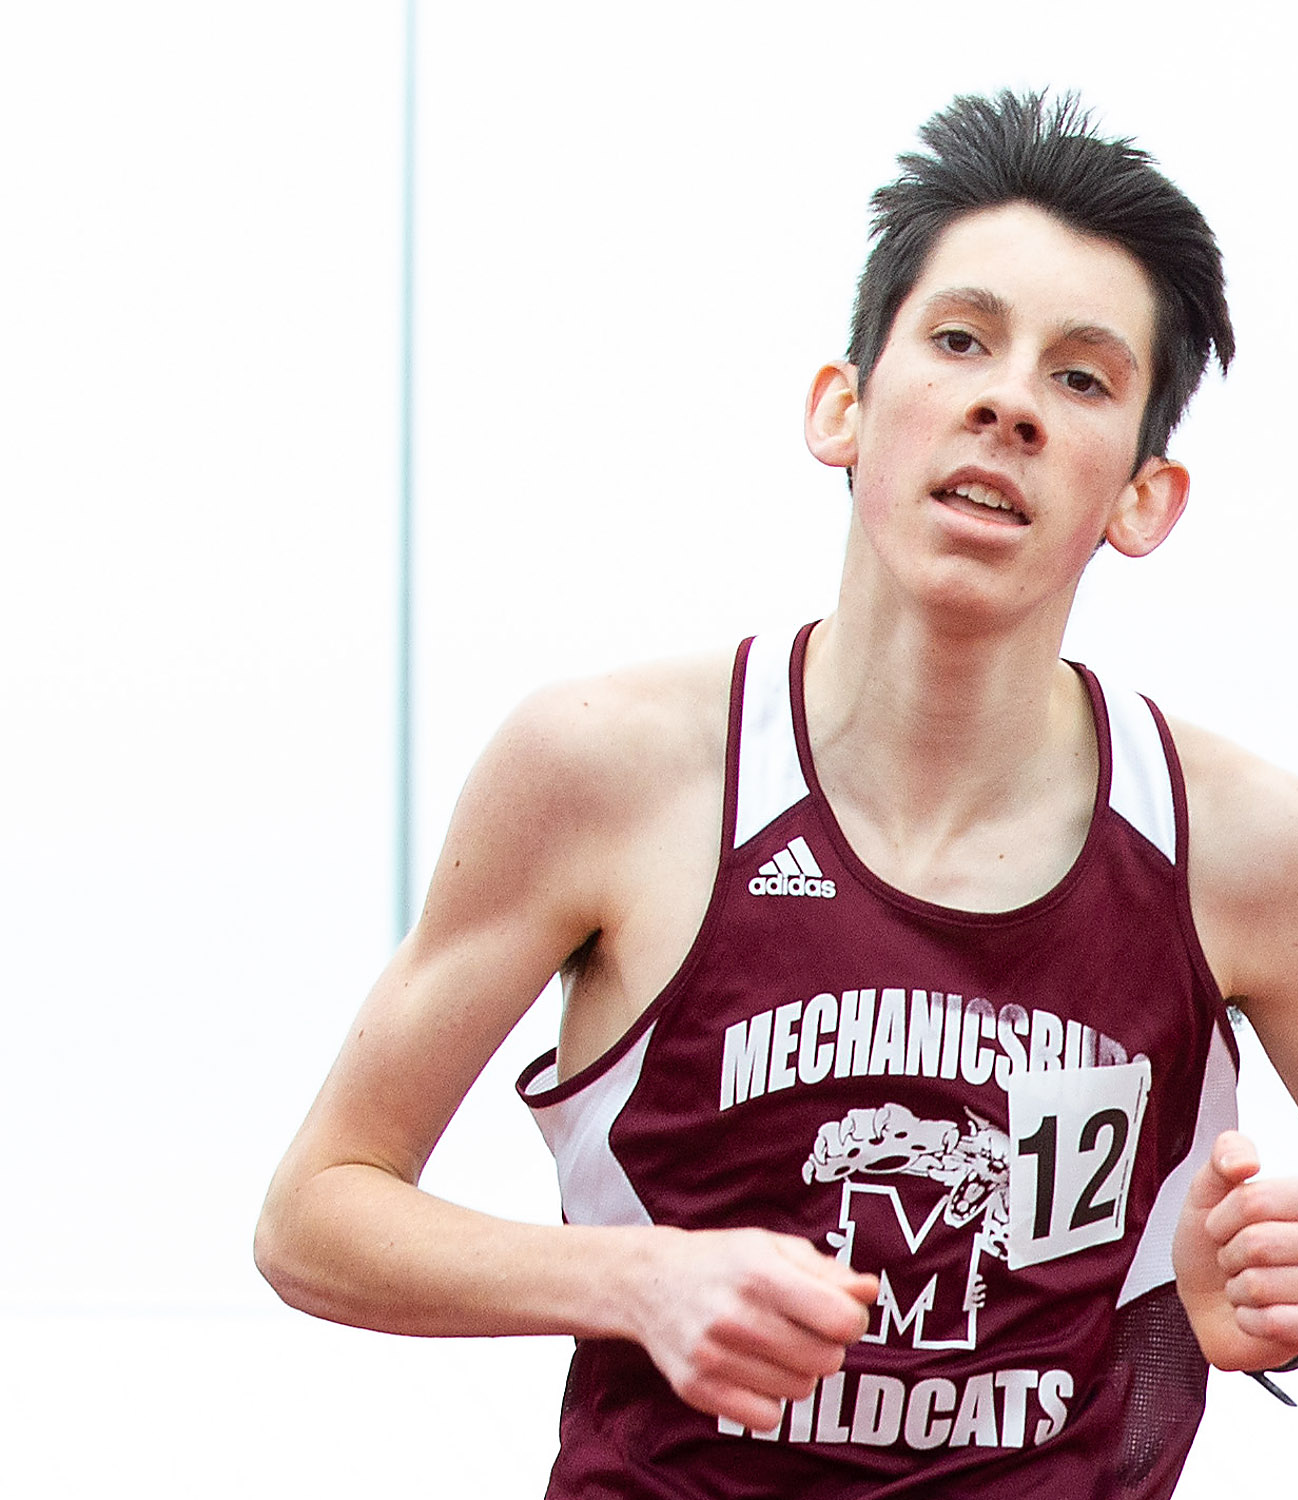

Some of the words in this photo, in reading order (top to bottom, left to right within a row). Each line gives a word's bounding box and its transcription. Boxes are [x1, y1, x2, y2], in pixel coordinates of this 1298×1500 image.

[747, 872, 837, 899] adidas
[1018, 1107, 1129, 1241] 12
[717, 1368, 1075, 1450] ILDCATS
